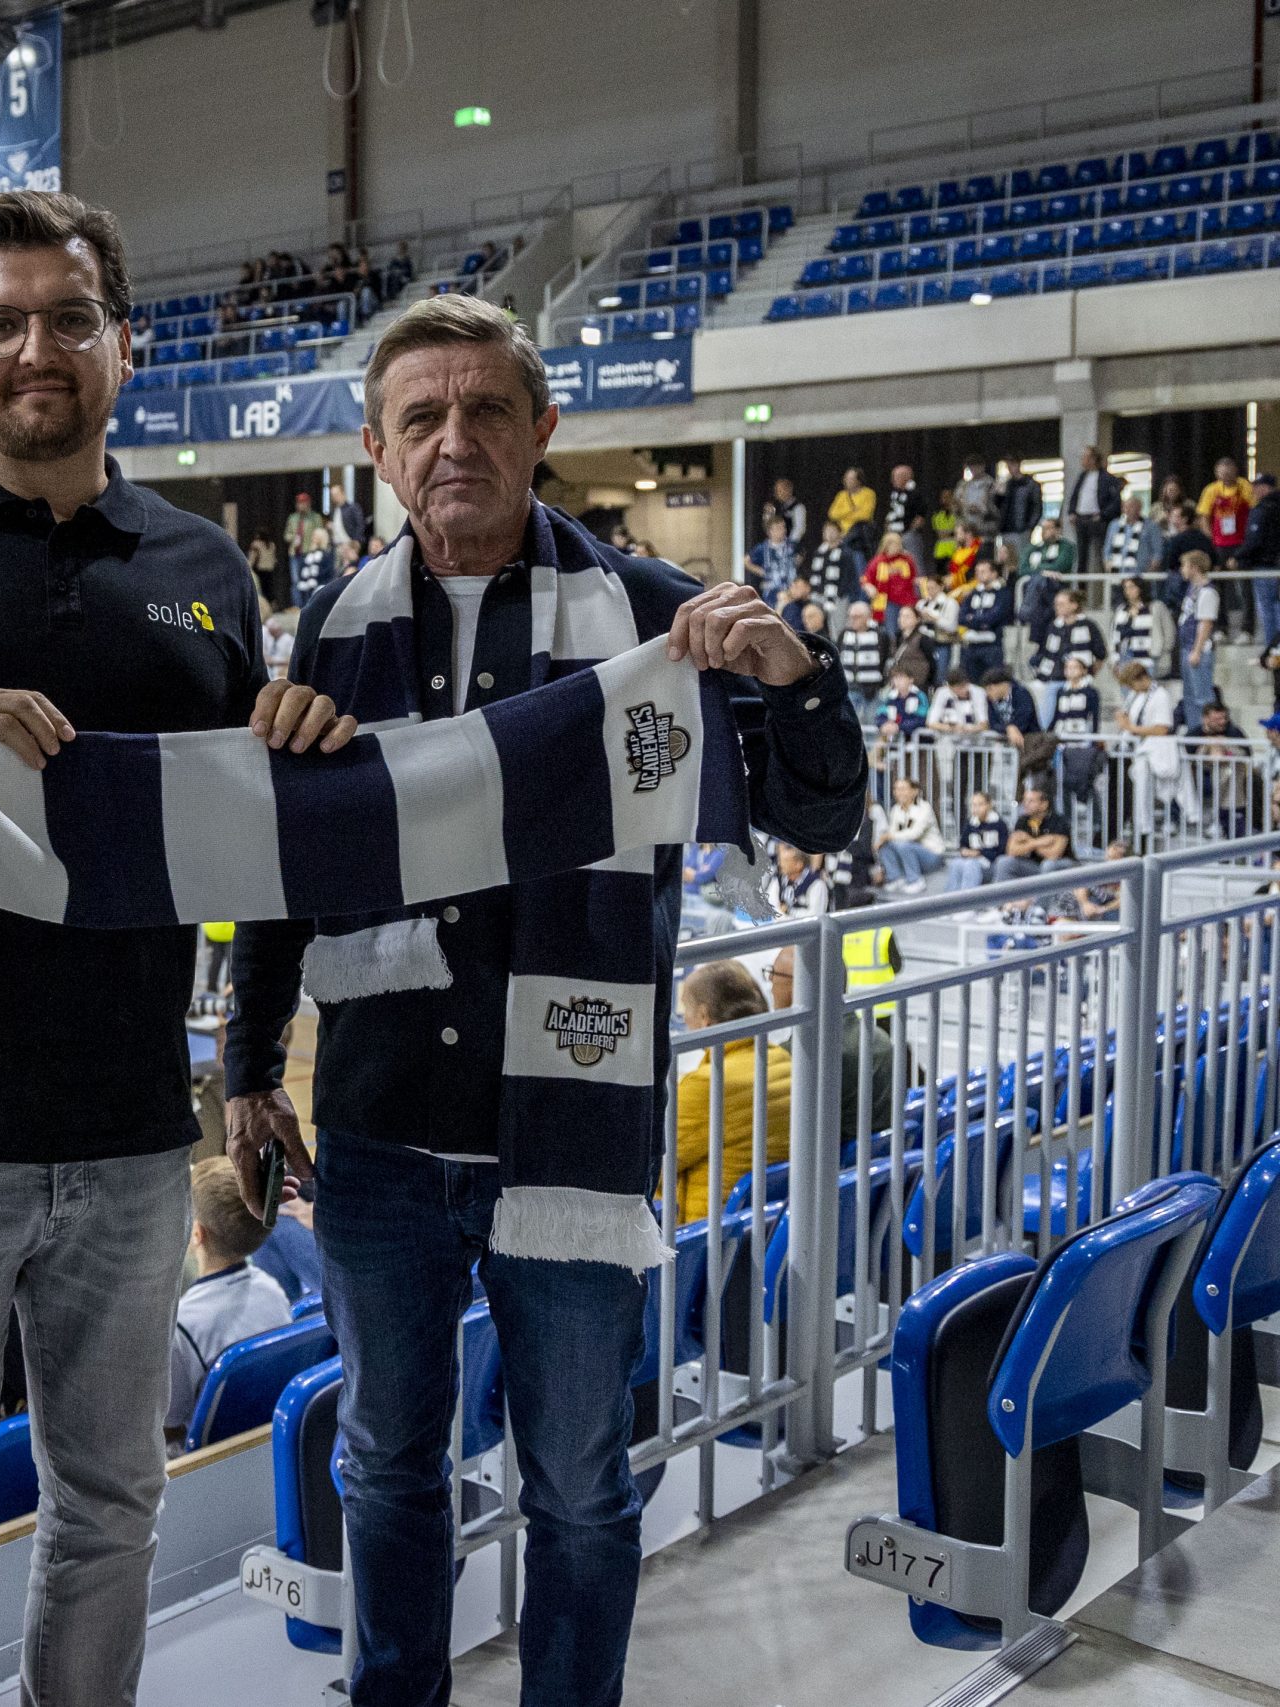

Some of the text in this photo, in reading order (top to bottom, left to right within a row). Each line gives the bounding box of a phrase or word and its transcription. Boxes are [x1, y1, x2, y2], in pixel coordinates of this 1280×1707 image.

[9, 70, 29, 117] 5
[229, 400, 281, 438] LAB
[630, 705, 660, 789] ACADEMICS
[631, 734, 643, 757] MLP
[655, 716, 674, 776] HEIDELBERG
[547, 1005, 628, 1036] ACADEMICS
[585, 1003, 608, 1015] MLP
[560, 1030, 615, 1051] HEIDELBERG
